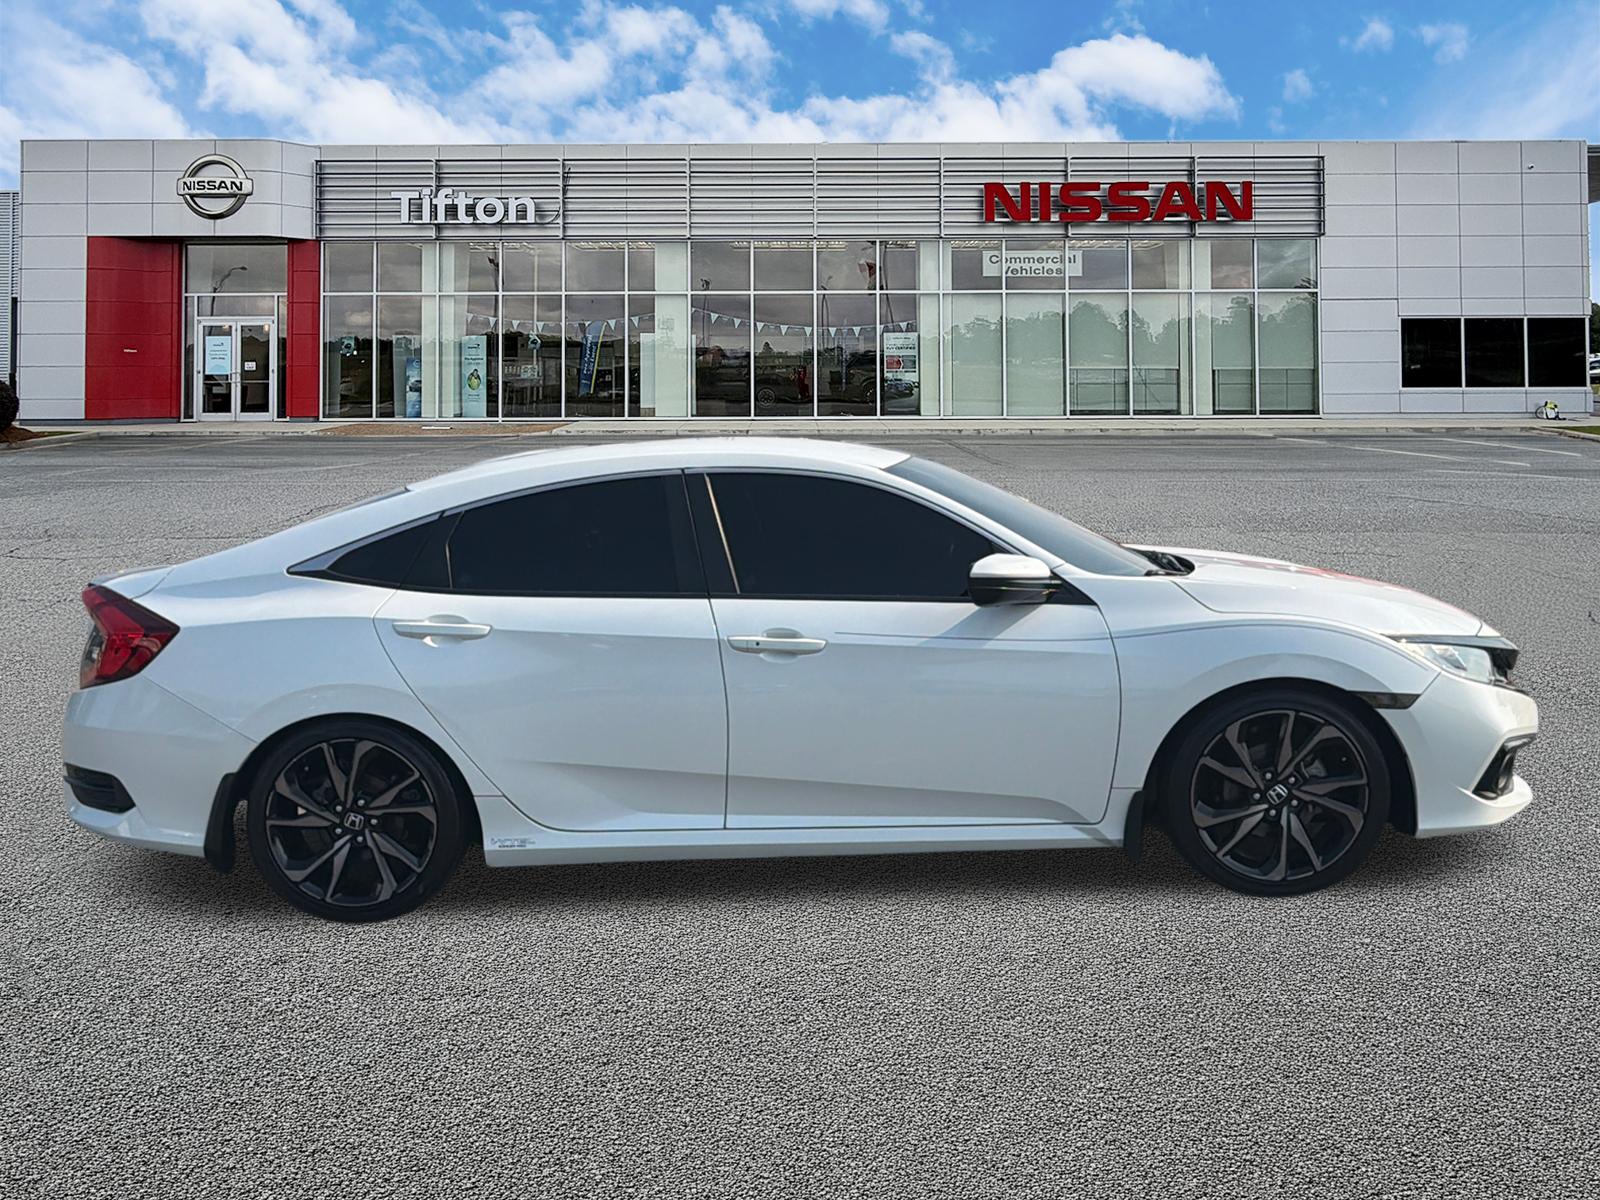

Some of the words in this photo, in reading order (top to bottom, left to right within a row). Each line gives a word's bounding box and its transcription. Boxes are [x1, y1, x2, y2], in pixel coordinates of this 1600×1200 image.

[183, 180, 243, 191] NISSAN
[984, 181, 1253, 222] NISSAN
[391, 188, 536, 224] Tifton
